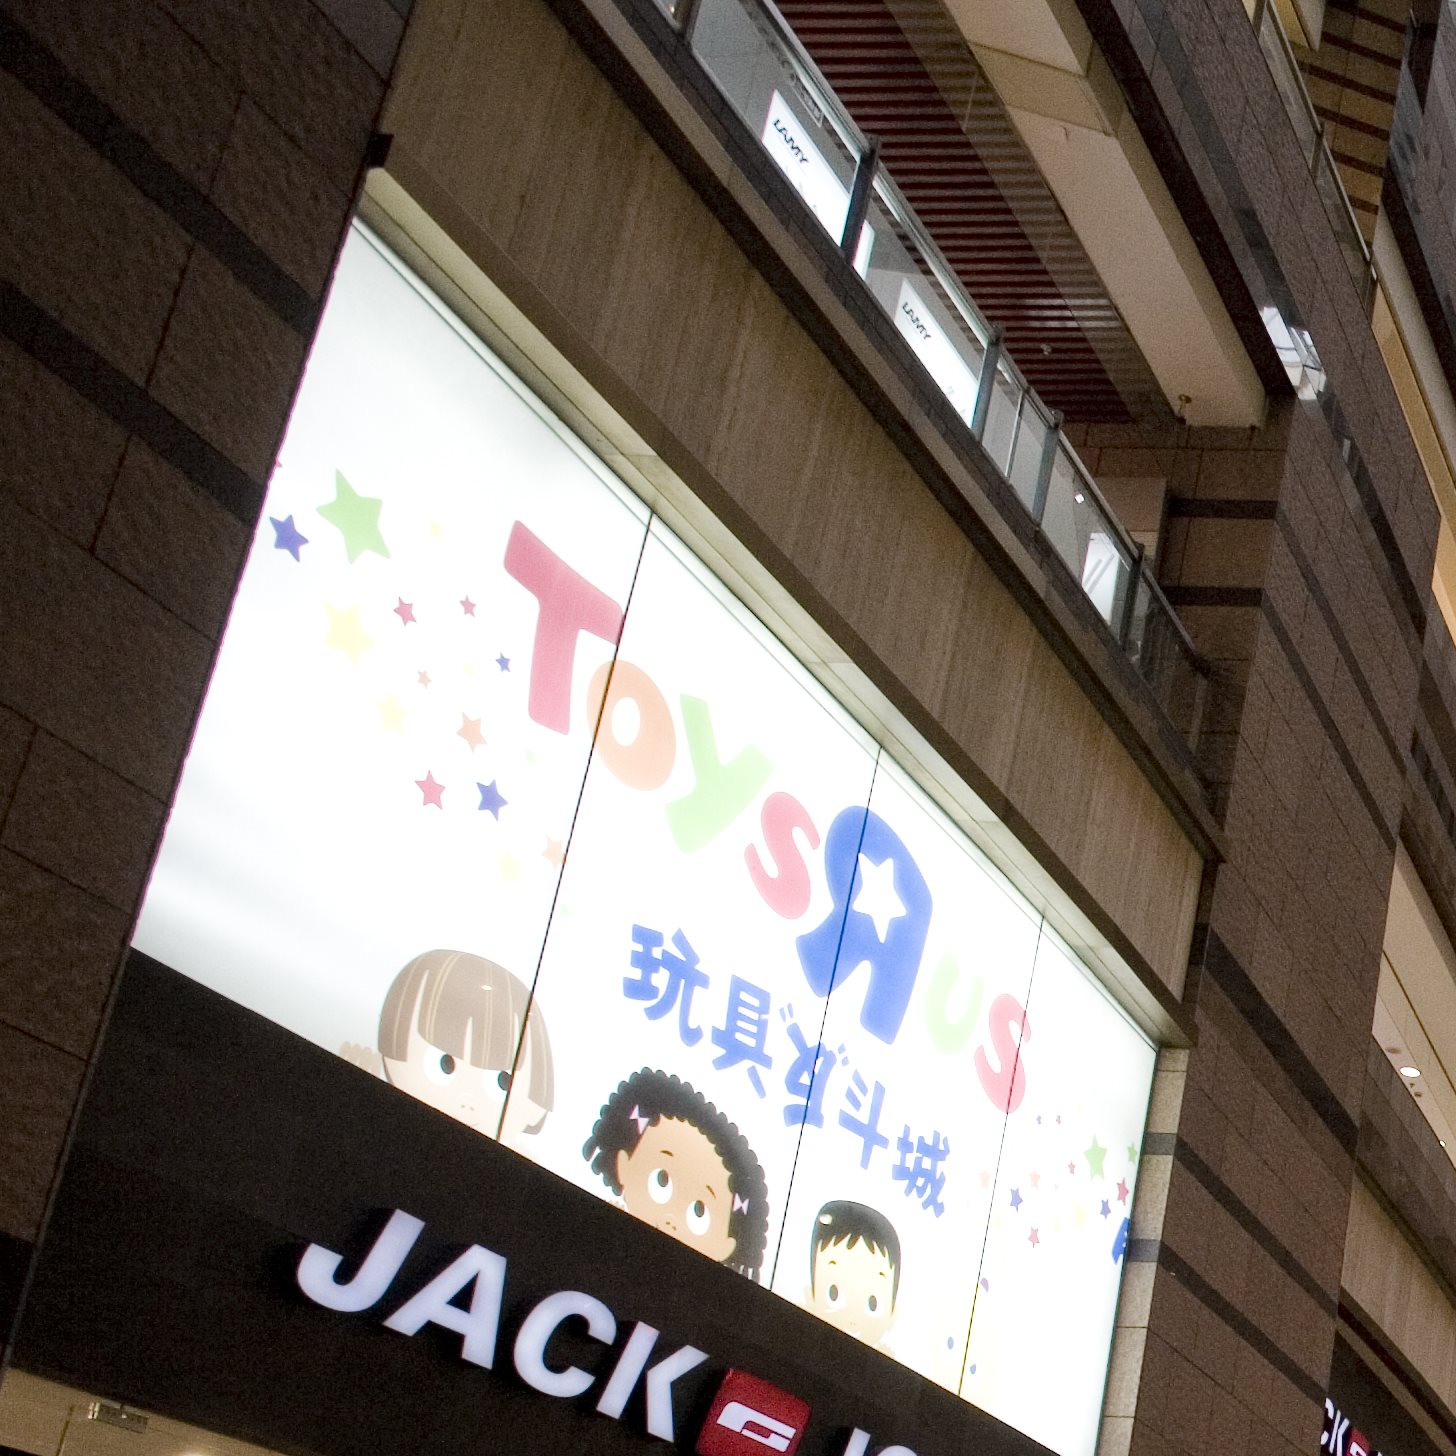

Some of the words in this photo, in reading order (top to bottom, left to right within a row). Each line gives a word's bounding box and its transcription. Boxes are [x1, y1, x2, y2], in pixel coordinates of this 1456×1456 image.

[773, 119, 808, 163] LAMY
[902, 302, 931, 340] LAMY
[297, 1208, 710, 1444] JACK
